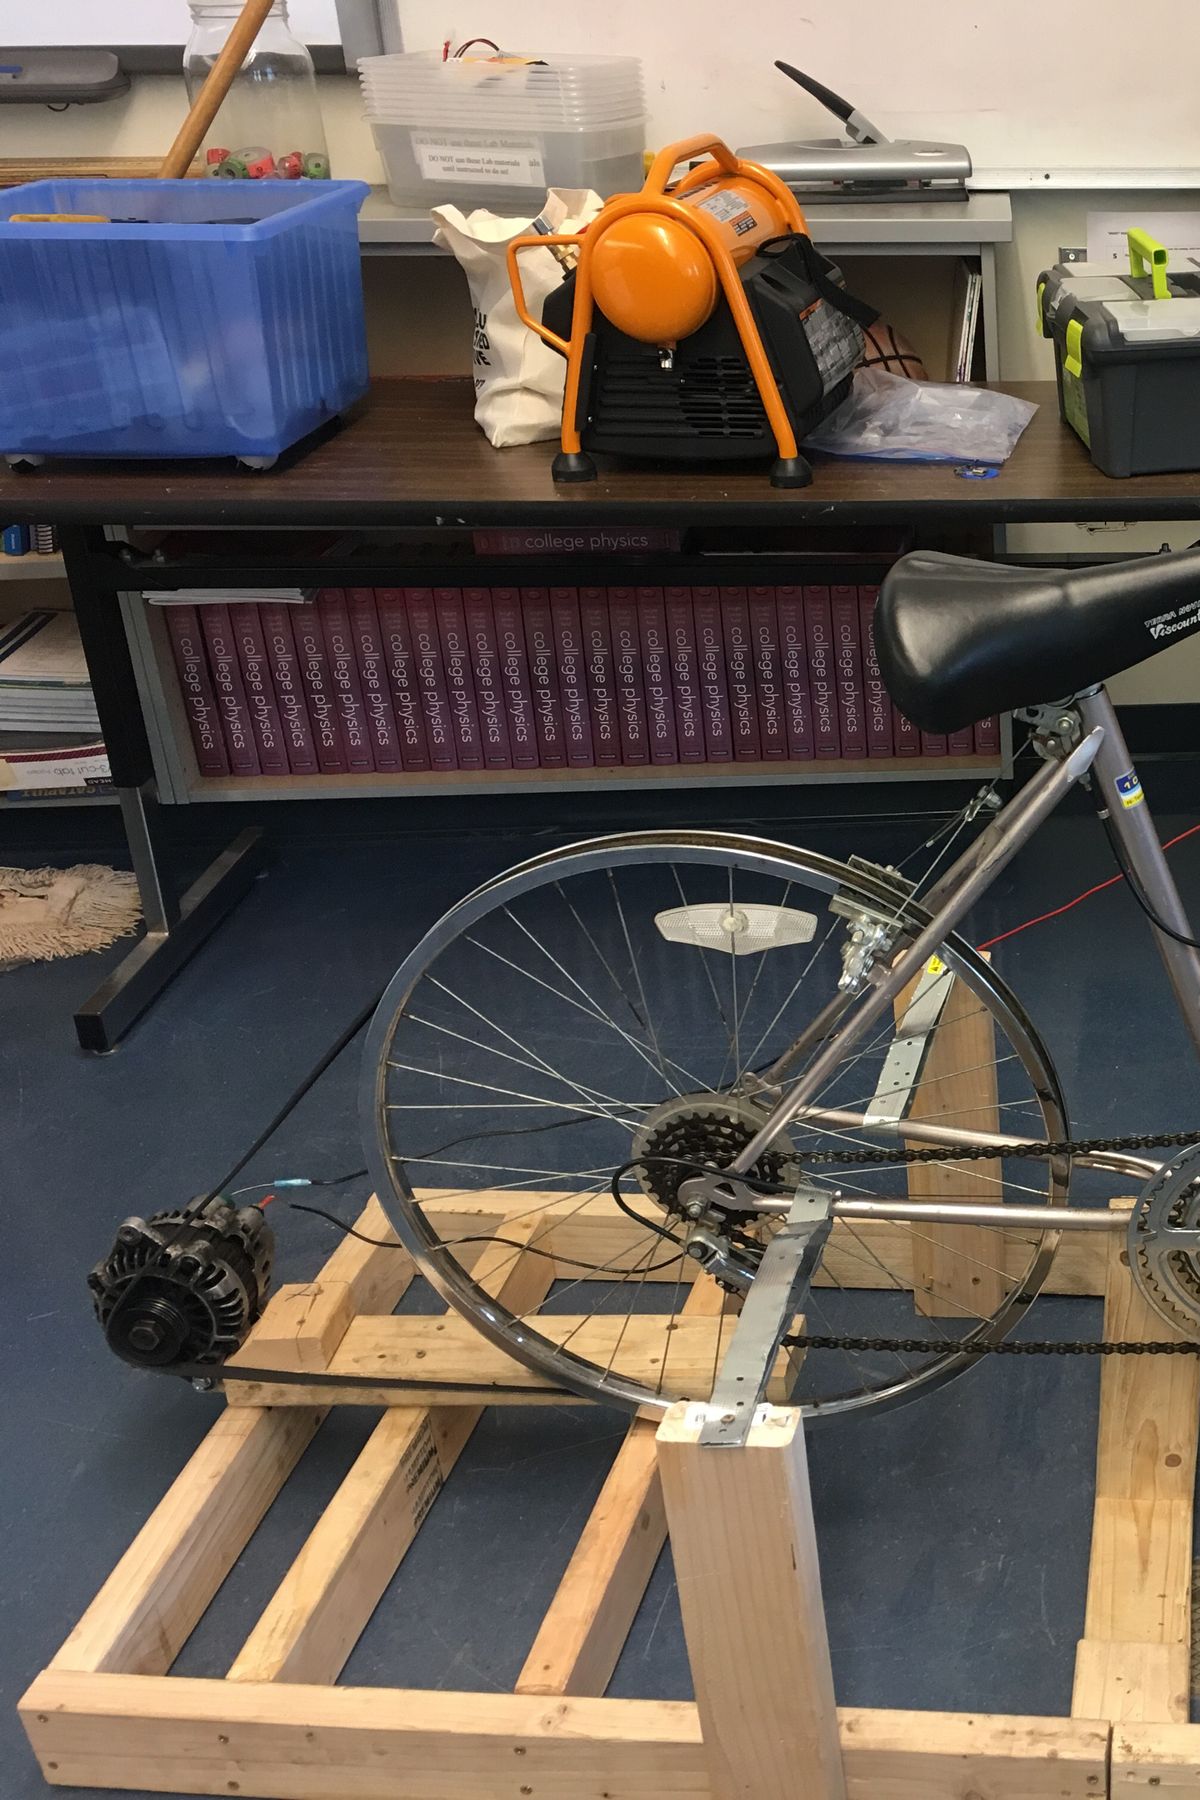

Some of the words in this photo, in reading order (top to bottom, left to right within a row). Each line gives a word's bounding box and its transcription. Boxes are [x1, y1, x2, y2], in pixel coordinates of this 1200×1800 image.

[440, 155, 453, 163] NOT
[525, 533, 584, 551] college
[590, 533, 648, 550] physics
[180, 638, 202, 692] college
[212, 638, 233, 692] college
[243, 637, 263, 691] college
[273, 636, 293, 690] college
[303, 636, 324, 690] college
[332, 635, 352, 689] college
[361, 634, 380, 689] college
[390, 634, 410, 688] college
[418, 633, 438, 687] college
[447, 632, 466, 686] college
[476, 632, 495, 687] college
[504, 632, 522, 686] college
[533, 631, 552, 685] college
[561, 630, 580, 684] college
[590, 630, 609, 684] college
[618, 630, 637, 684] college
[646, 629, 665, 682] college
[674, 628, 692, 681] college
[702, 628, 720, 681] college
[730, 626, 748, 680] college
[758, 626, 776, 680] college
[784, 626, 802, 678] college
[811, 624, 830, 677] college
[838, 624, 857, 677] college
[188, 697, 215, 750] physics
[220, 696, 246, 749] physics
[251, 696, 276, 748] physics
[280, 695, 306, 748] physics
[310, 694, 336, 747] physics
[338, 694, 363, 746] physics
[367, 693, 392, 746] physics
[395, 692, 420, 745] physics
[423, 691, 447, 744] physics
[451, 690, 475, 743] physics
[479, 691, 502, 743] physics
[507, 690, 530, 742] physics
[536, 689, 558, 742] physics
[564, 688, 586, 740] physics
[592, 688, 614, 740] physics
[620, 688, 642, 740] physics
[648, 687, 670, 738] physics
[676, 685, 698, 737] physics
[704, 685, 725, 737] physics
[732, 684, 753, 736] physics
[760, 684, 781, 735] physics
[786, 682, 807, 734] physics
[813, 682, 833, 733] physics
[840, 682, 860, 733] physics
[867, 680, 887, 732] physics
